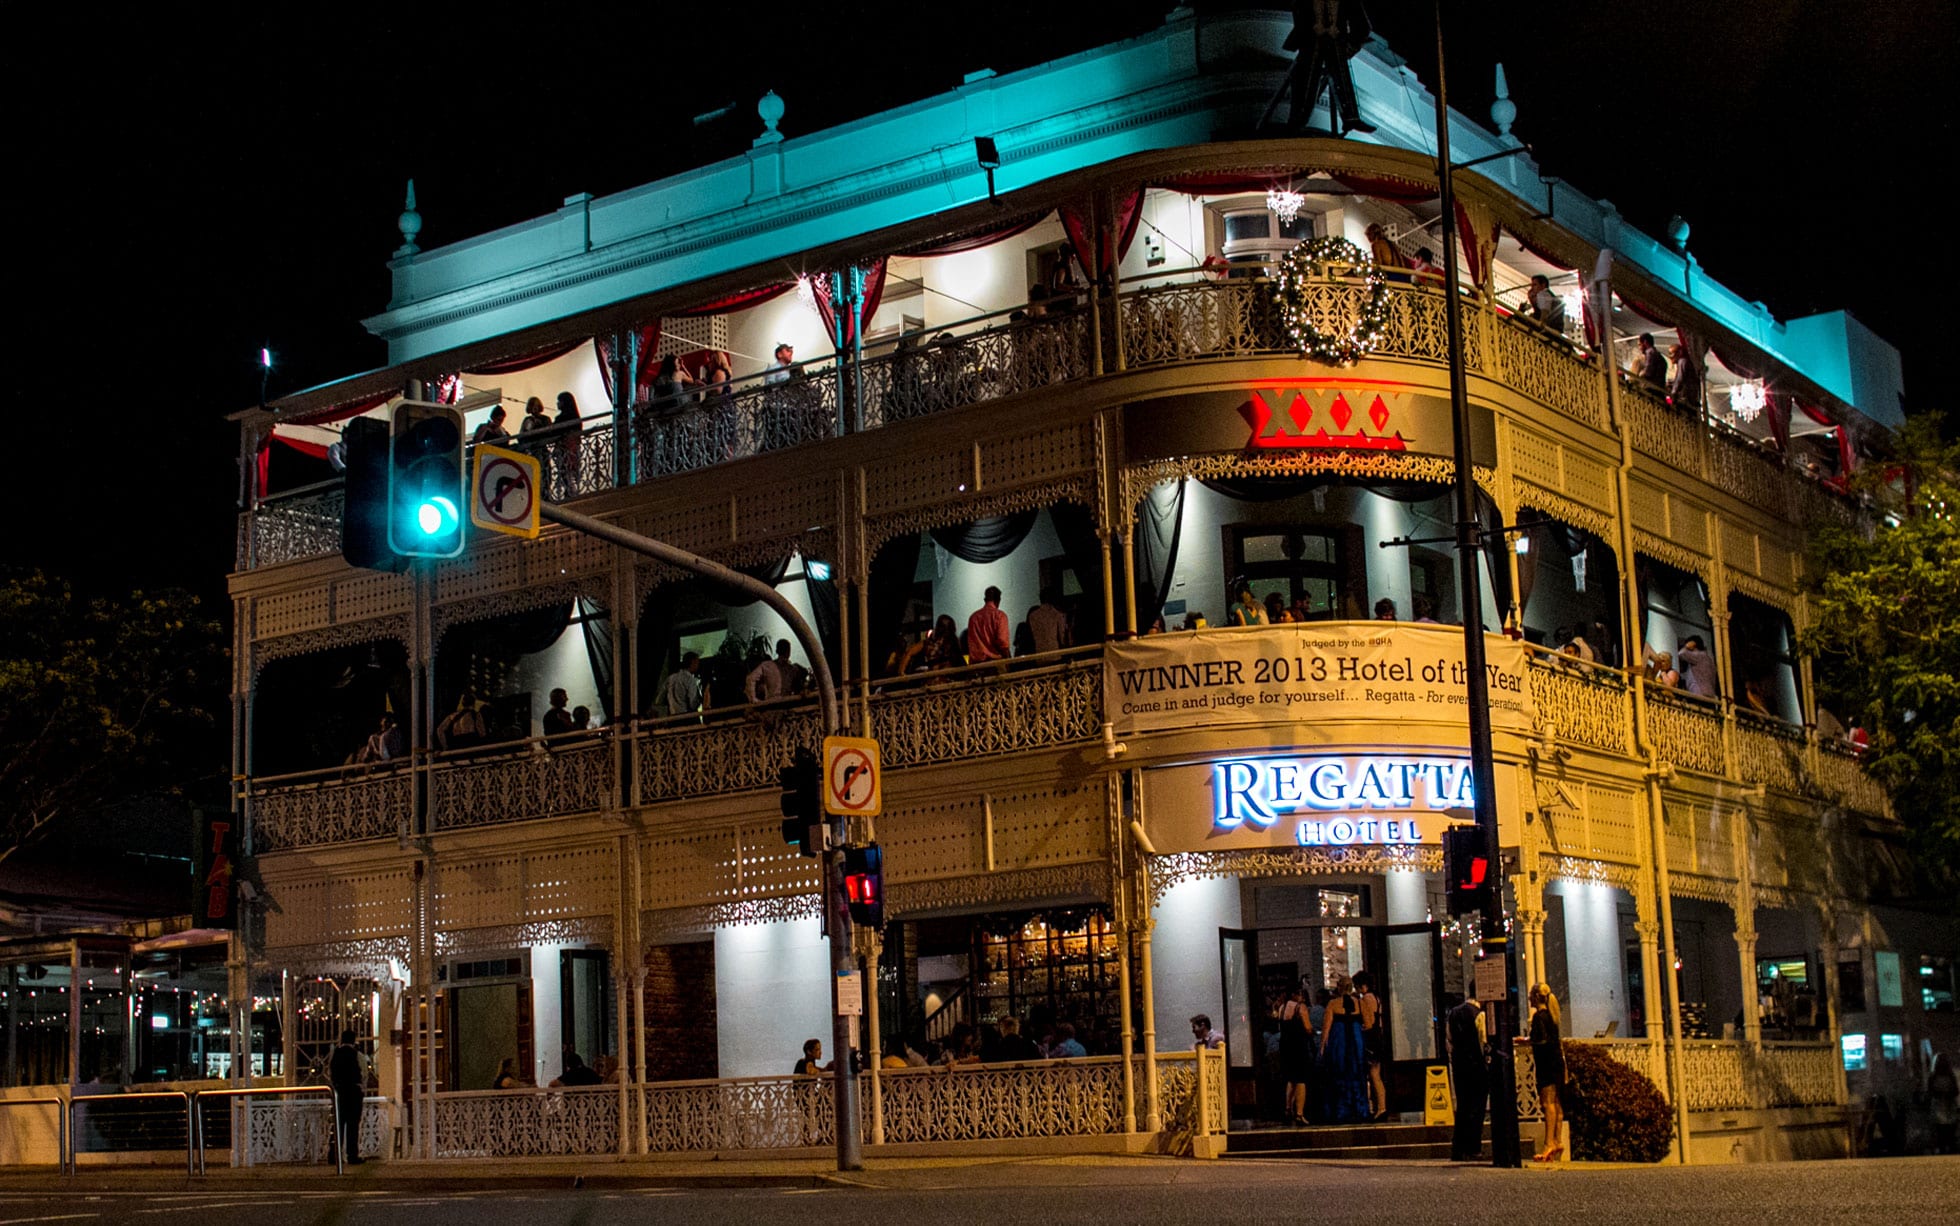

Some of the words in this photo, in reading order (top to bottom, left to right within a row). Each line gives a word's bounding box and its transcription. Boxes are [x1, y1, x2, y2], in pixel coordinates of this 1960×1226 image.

[1256, 388, 1416, 441] XXXX
[1302, 639, 1336, 650] Judged
[1338, 639, 1350, 649] by
[1351, 639, 1366, 648] the
[1117, 660, 1245, 696] WINNER
[1254, 656, 1328, 684] 2013
[1336, 656, 1414, 682] Hotel
[1421, 658, 1446, 684] of
[1450, 660, 1468, 685] th
[1485, 664, 1522, 694] Year
[1121, 701, 1161, 716] Come
[1165, 697, 1178, 711] in
[1181, 694, 1209, 709] and
[1211, 691, 1255, 710] judge
[1259, 690, 1281, 704] for
[1284, 688, 1360, 706] yourself...
[1365, 688, 1416, 705] Regatta
[1425, 690, 1445, 704] For
[1302, 820, 1423, 844] HOTEL
[206, 822, 233, 919] TAB
